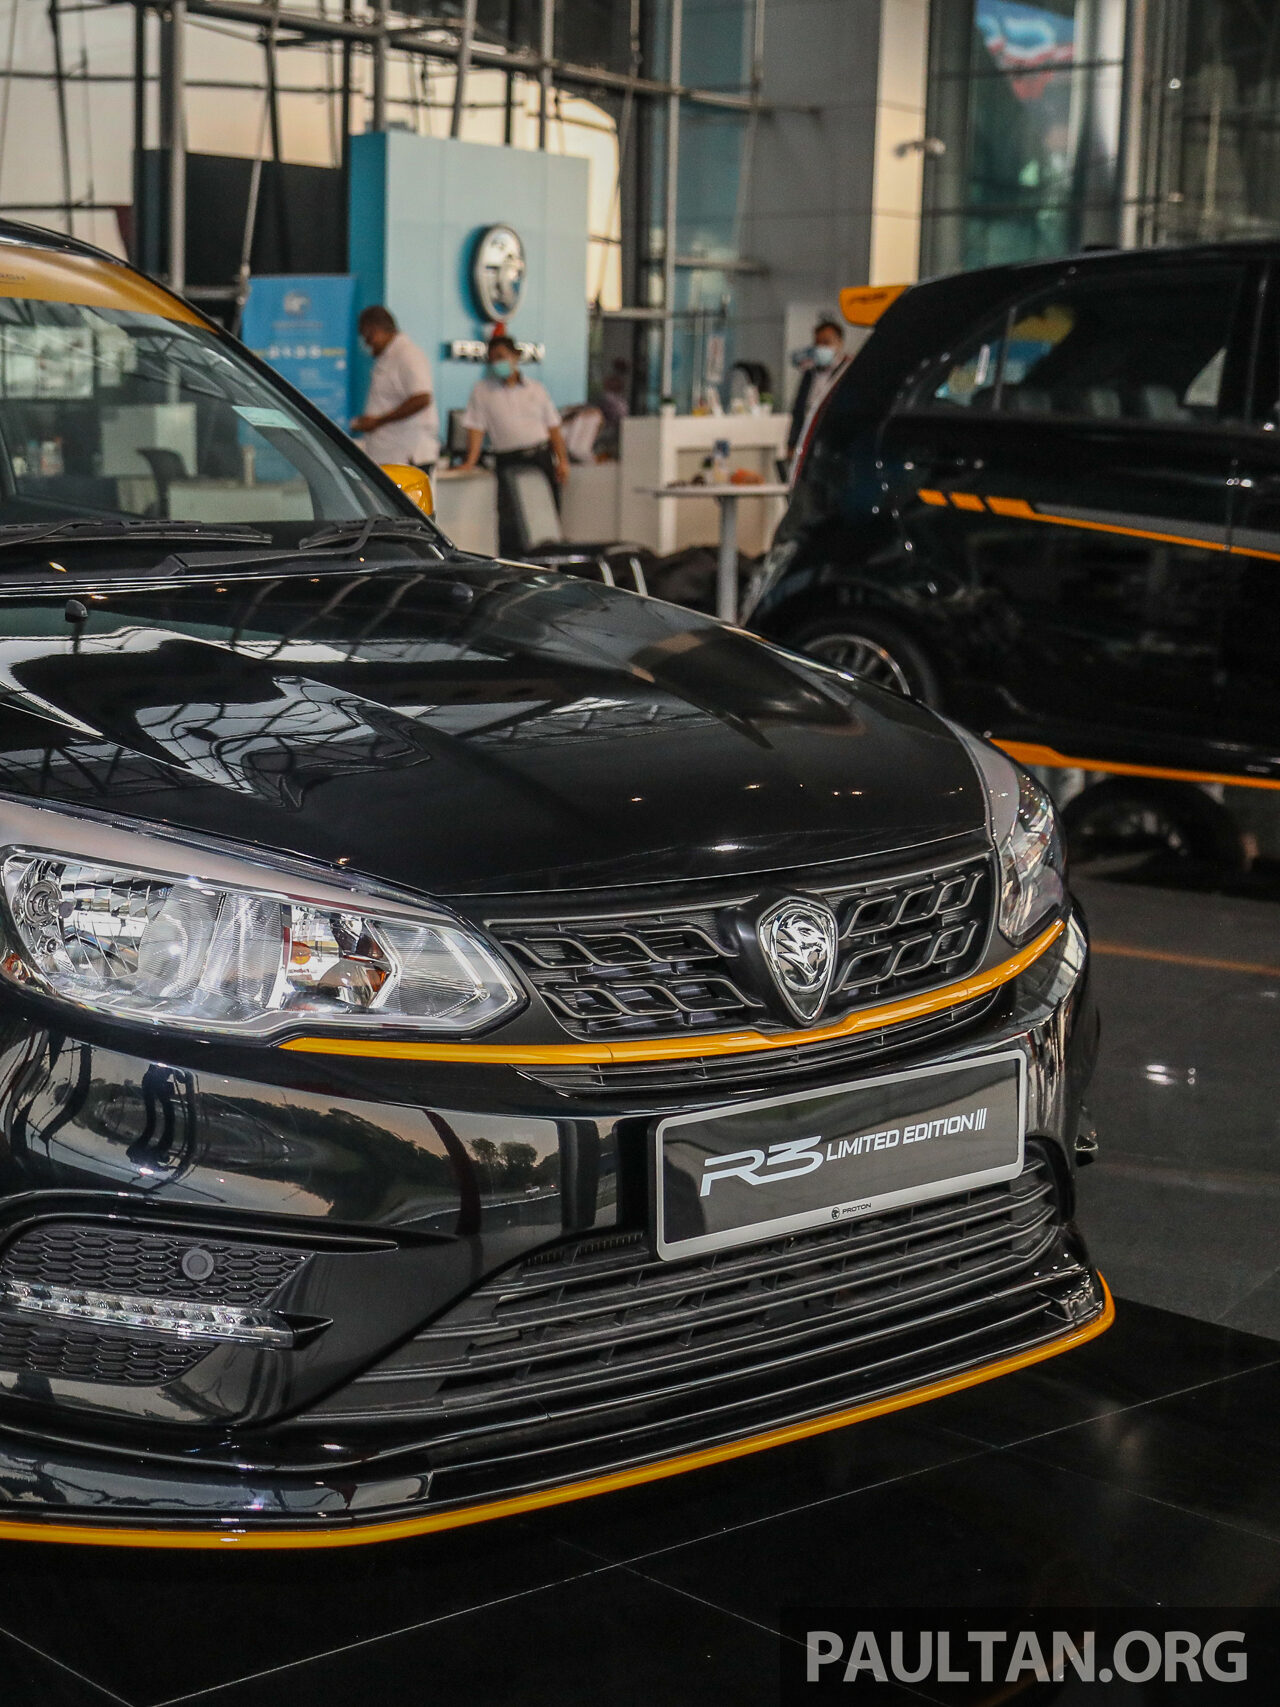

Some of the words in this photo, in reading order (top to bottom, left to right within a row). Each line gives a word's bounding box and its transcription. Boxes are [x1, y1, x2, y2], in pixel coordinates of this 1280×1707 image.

[699, 1135, 824, 1197] R3
[825, 1129, 900, 1162] LIMITED
[841, 1203, 872, 1215] PROTON
